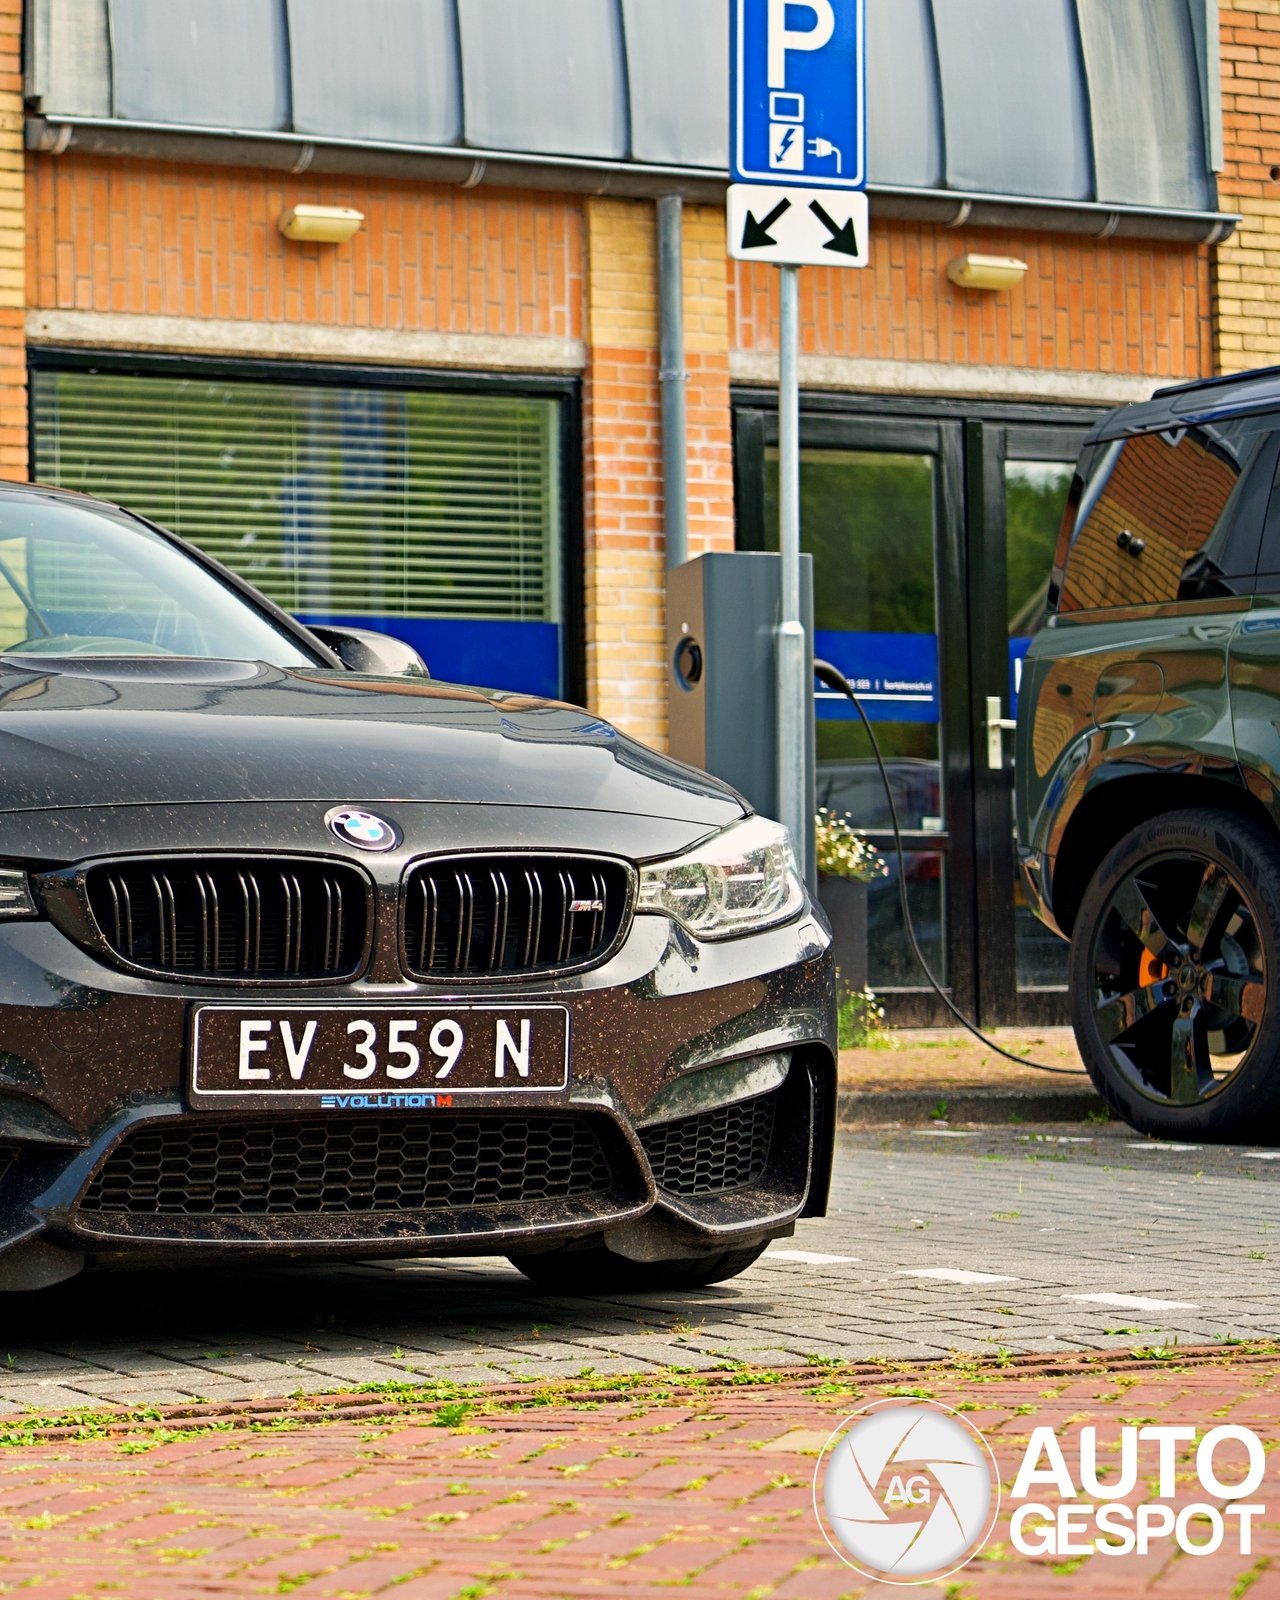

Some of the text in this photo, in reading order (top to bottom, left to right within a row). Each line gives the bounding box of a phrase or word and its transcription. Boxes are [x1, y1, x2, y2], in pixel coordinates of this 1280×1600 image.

[767, 0, 835, 89] P
[576, 900, 603, 911] M4
[238, 1018, 530, 1080] EV 359 N
